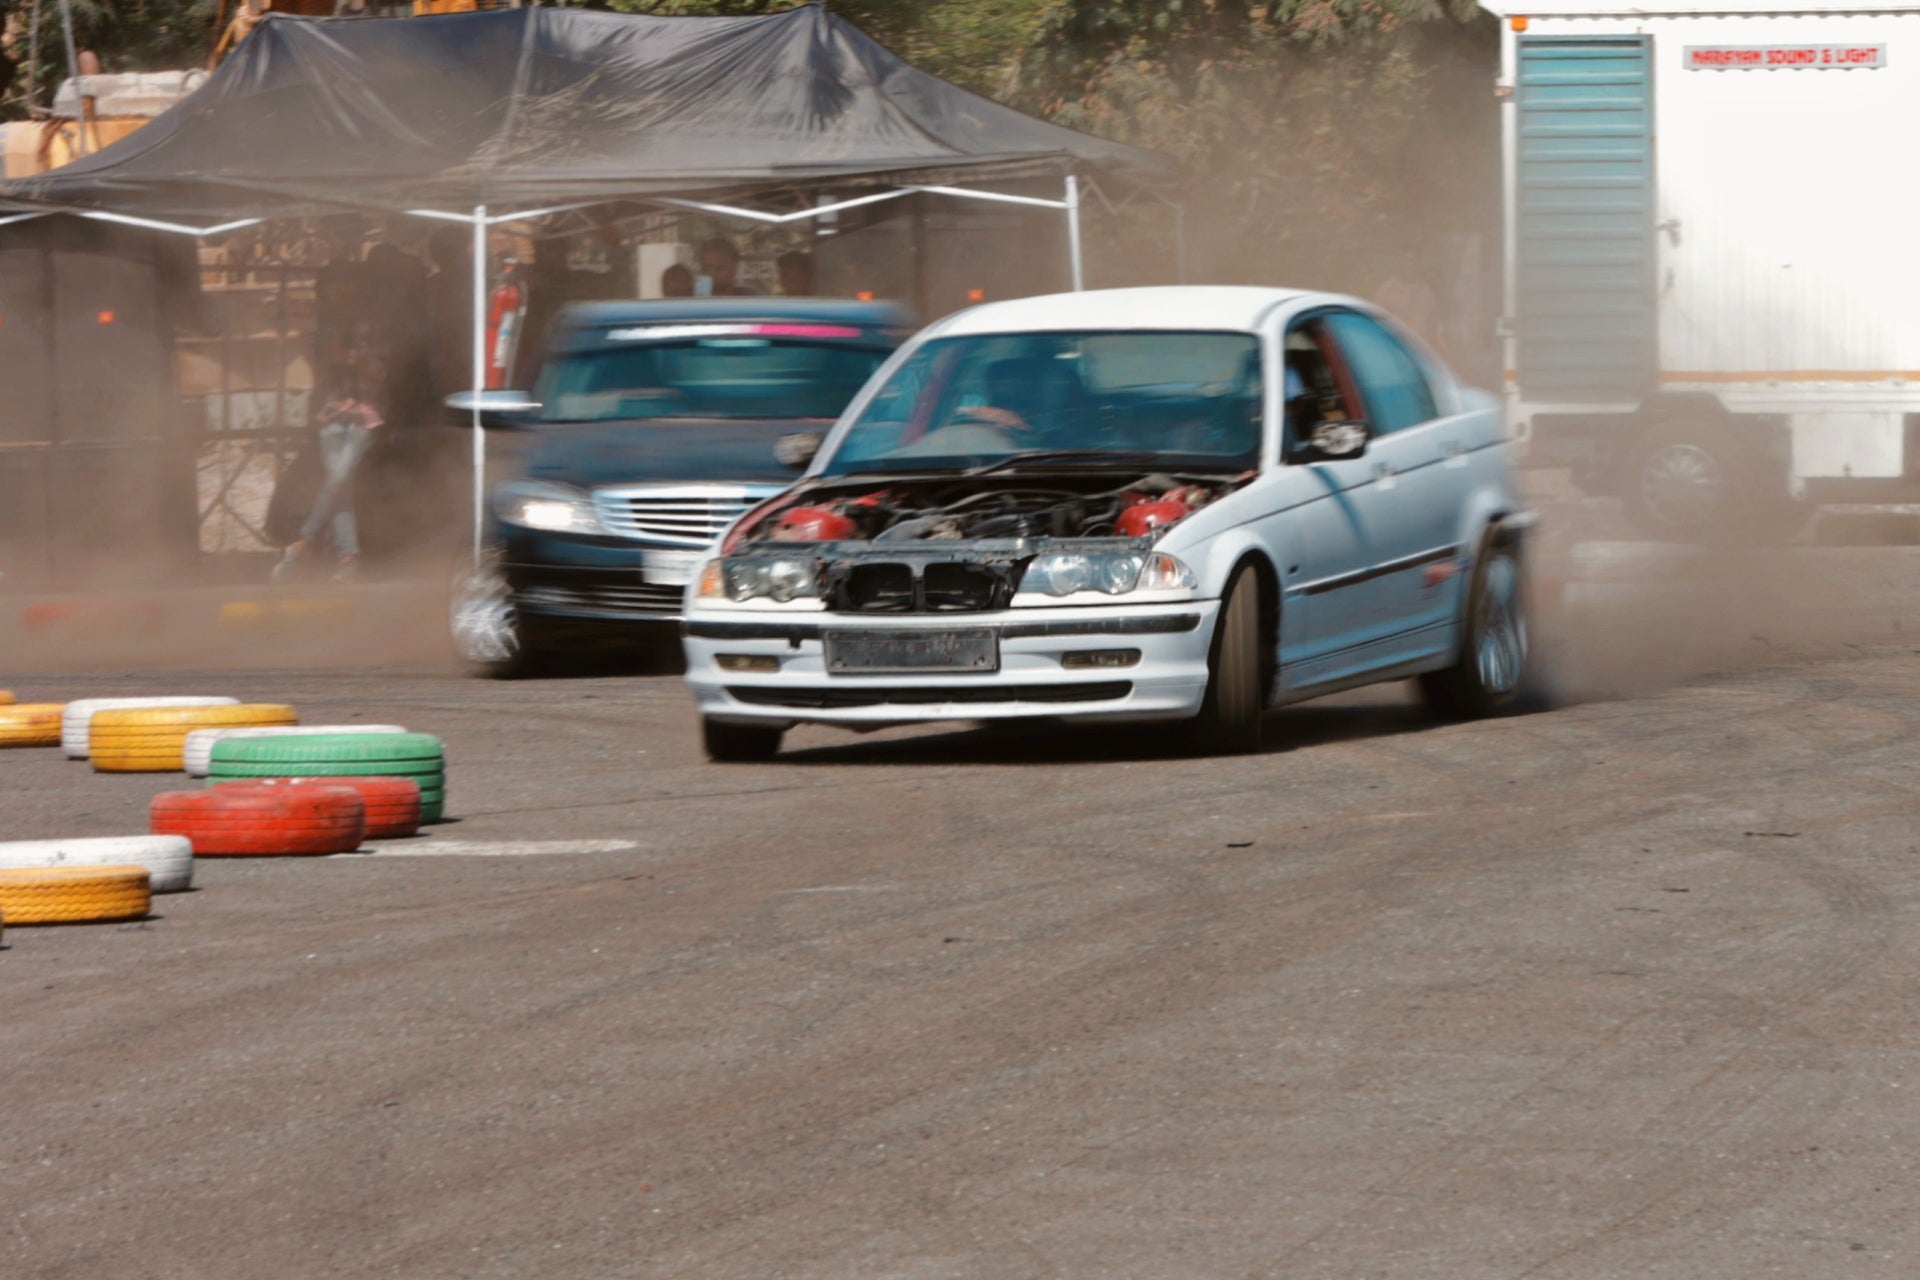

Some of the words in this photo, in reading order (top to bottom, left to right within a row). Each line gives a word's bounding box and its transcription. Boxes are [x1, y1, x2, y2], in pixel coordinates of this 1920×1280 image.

[1767, 49, 1817, 64] SOUND
[1821, 48, 1832, 64] &
[1837, 48, 1878, 63] LIGHT
